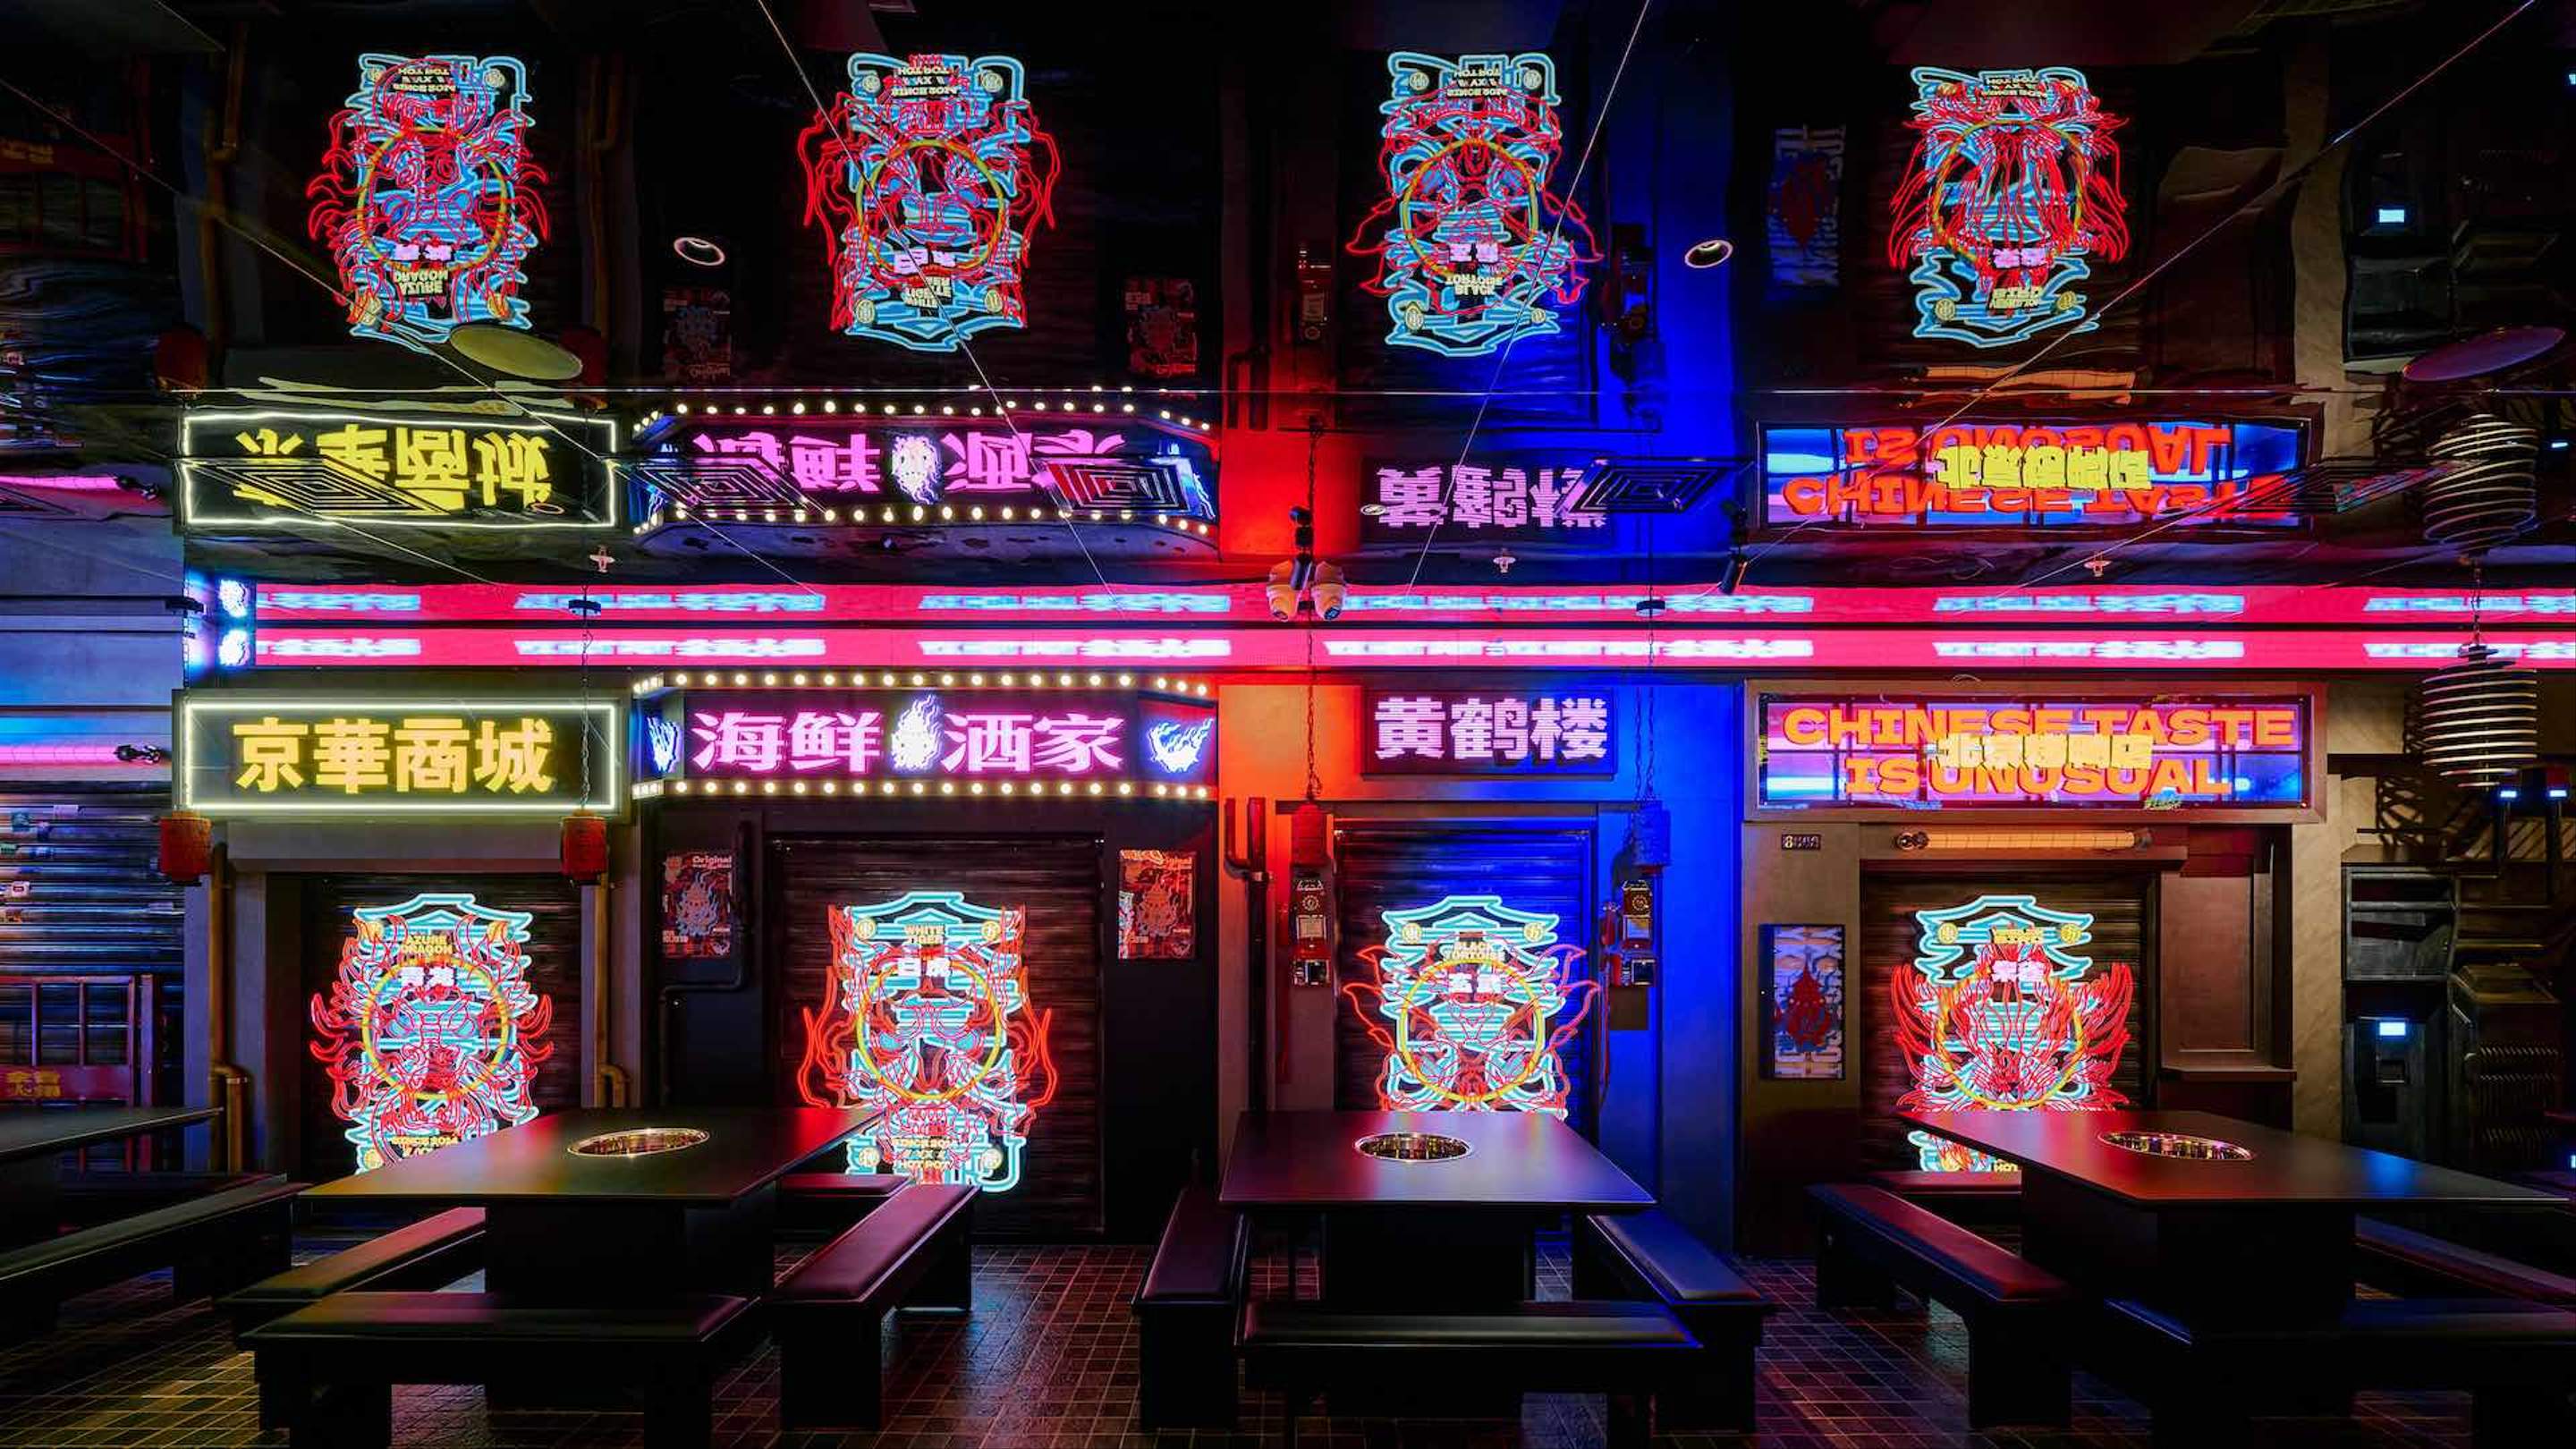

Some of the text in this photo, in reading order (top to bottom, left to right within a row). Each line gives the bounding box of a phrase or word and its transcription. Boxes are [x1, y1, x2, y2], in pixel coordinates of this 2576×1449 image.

[231, 716, 555, 794] 京華商城
[691, 711, 1126, 774] 海鲜 酒家
[1375, 698, 1608, 760] 黄鹤楼
[1783, 709, 2296, 745] CHINESE TASTE
[1843, 758, 2234, 795] IS UNUSUAL
